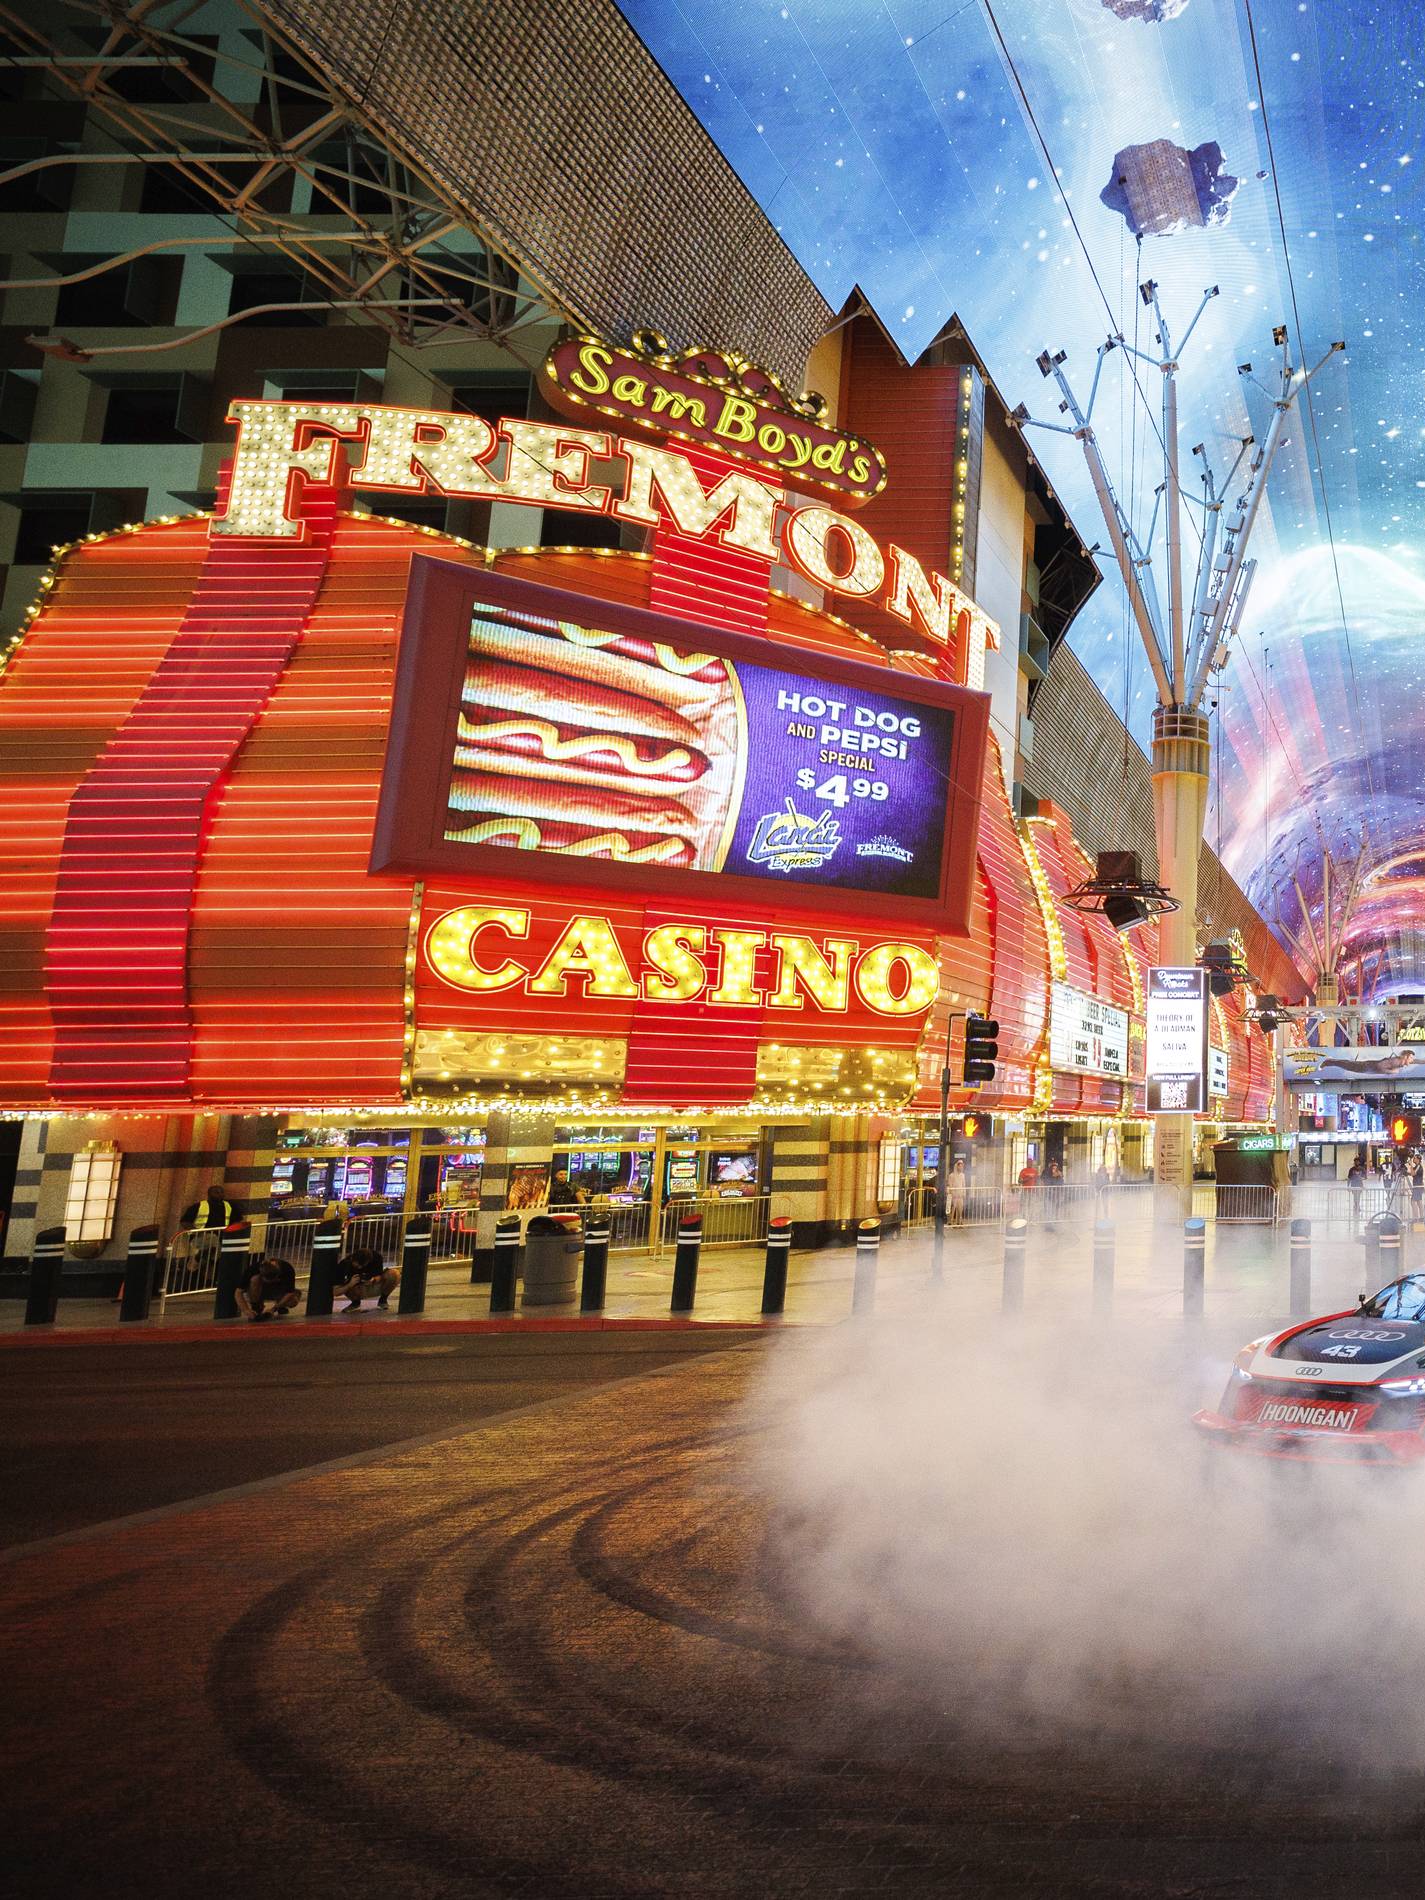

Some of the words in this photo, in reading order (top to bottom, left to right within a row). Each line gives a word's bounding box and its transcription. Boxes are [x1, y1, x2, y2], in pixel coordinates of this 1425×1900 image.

[569, 343, 706, 428] Sam
[716, 397, 871, 484] Boyd's
[209, 399, 1001, 690] FREMONT
[776, 690, 846, 722] HOT
[853, 706, 921, 738] DOG
[786, 722, 816, 740] AND
[820, 725, 907, 760] PEPSI
[819, 749, 876, 772] SPECIAL
[747, 812, 842, 862] Lanai
[856, 842, 914, 863] FREMONT
[769, 856, 823, 873] Express
[422, 904, 941, 1018] CASINO
[1168, 991, 1200, 999] CONCERT
[1156, 1014, 1183, 1022] THEORY
[1162, 1043, 1187, 1051] SALIVA
[1243, 1138, 1274, 1150] CIGARS
[1320, 1344, 1362, 1358] 43
